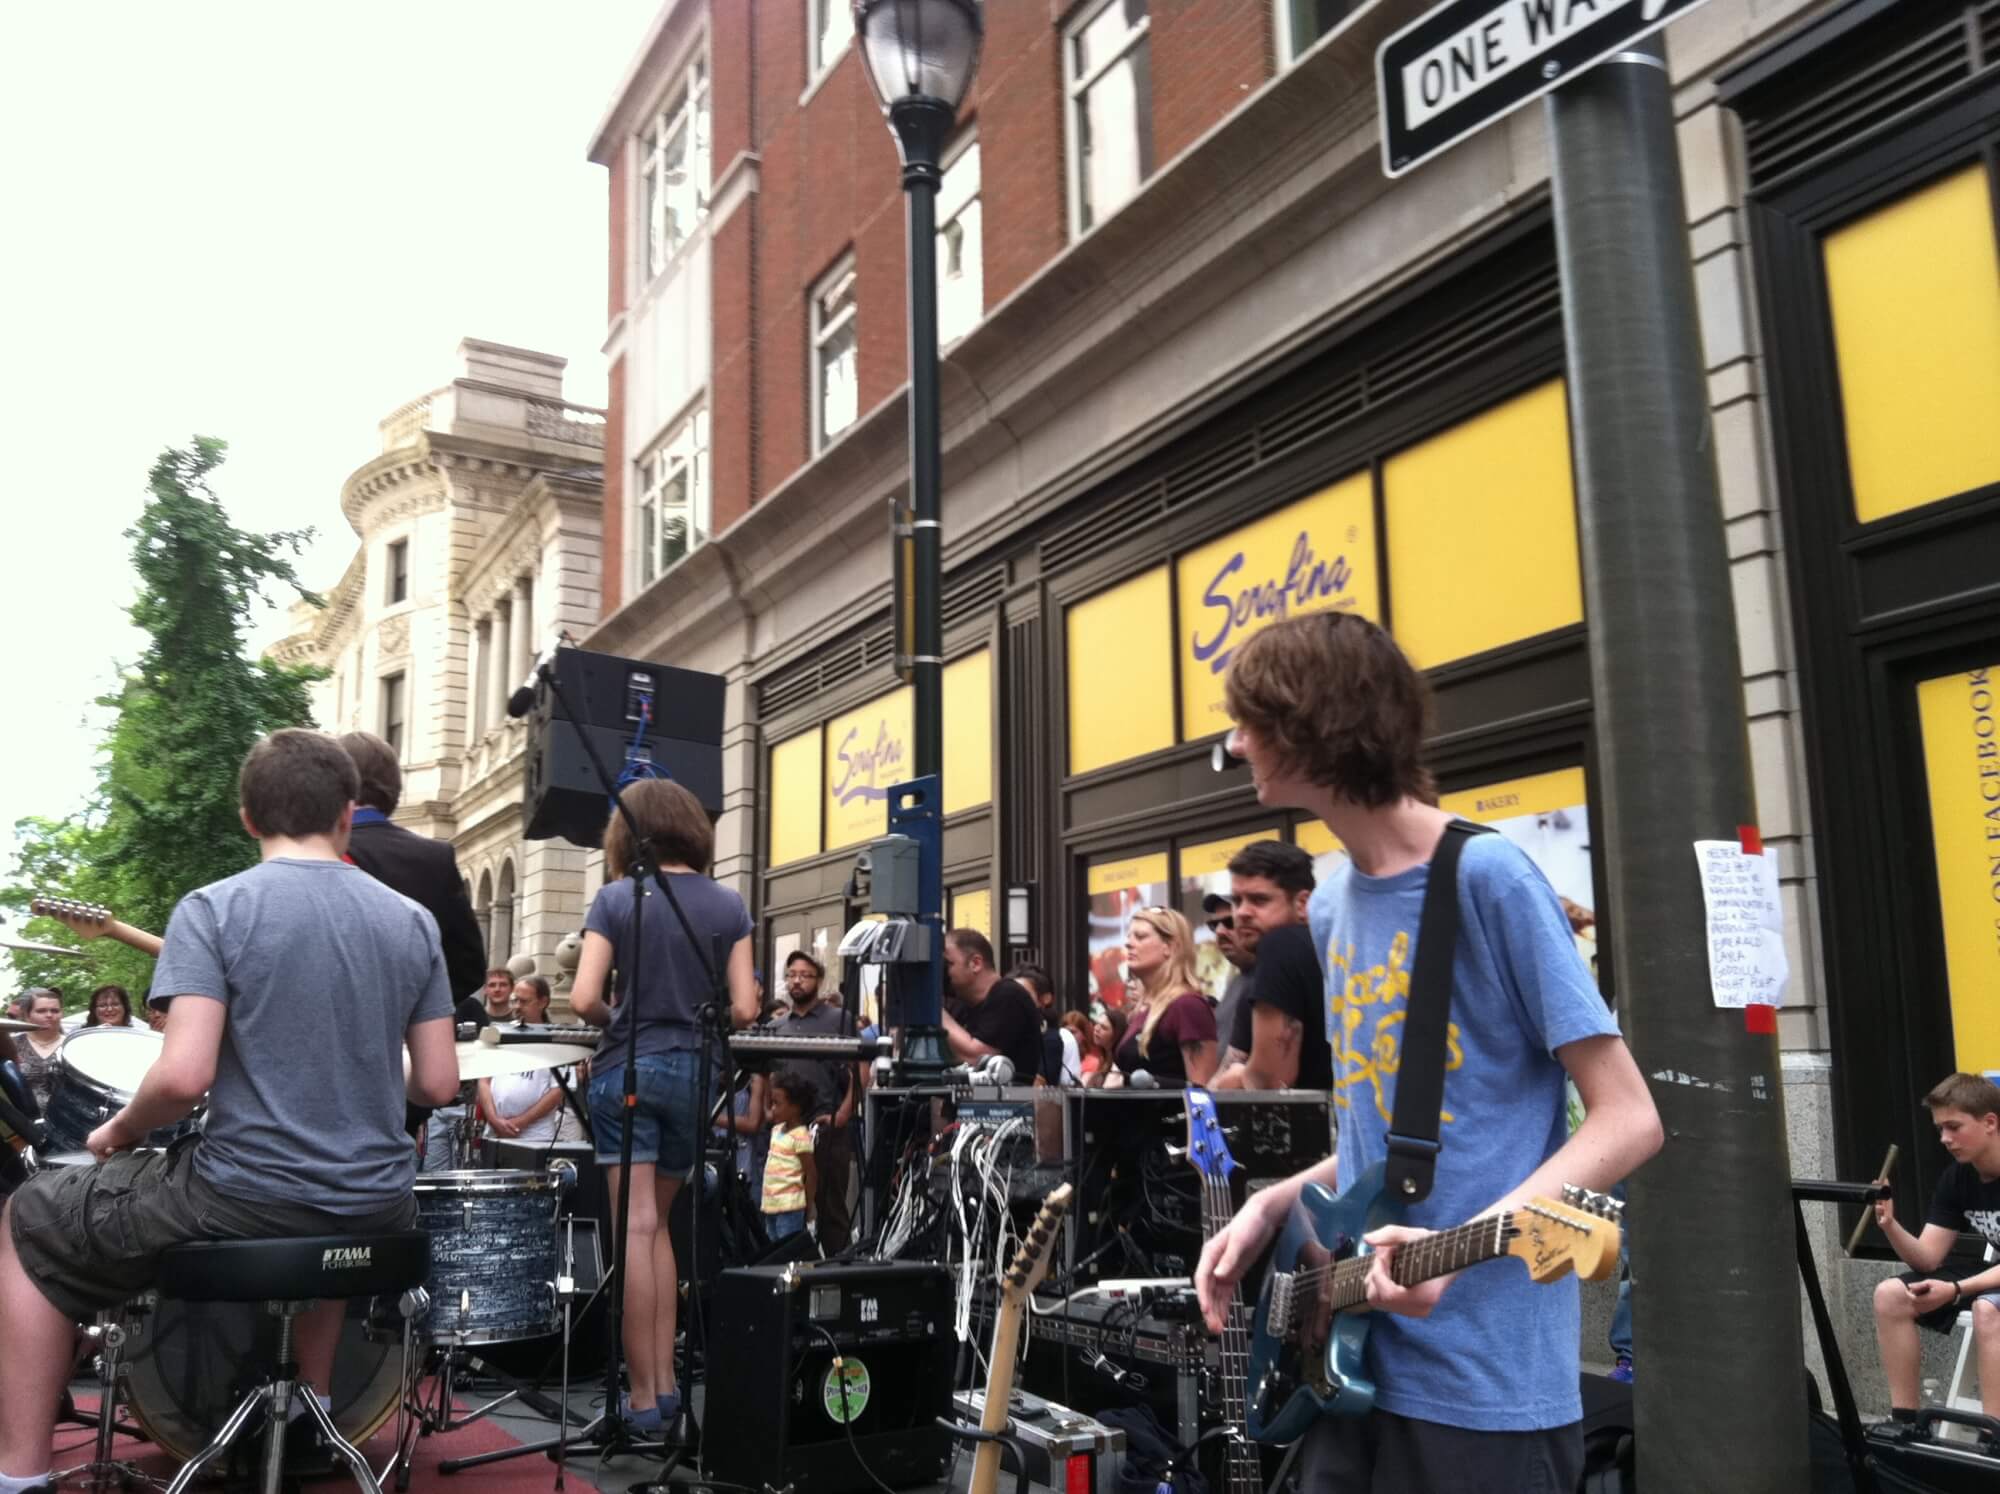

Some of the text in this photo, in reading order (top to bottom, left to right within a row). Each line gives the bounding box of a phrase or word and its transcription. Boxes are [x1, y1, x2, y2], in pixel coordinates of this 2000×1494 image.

[1421, 0, 1599, 108] ONE WA
[1193, 531, 1353, 661] Serafina
[1475, 793, 1521, 813] BAKERY
[334, 1246, 372, 1261] TAMA
